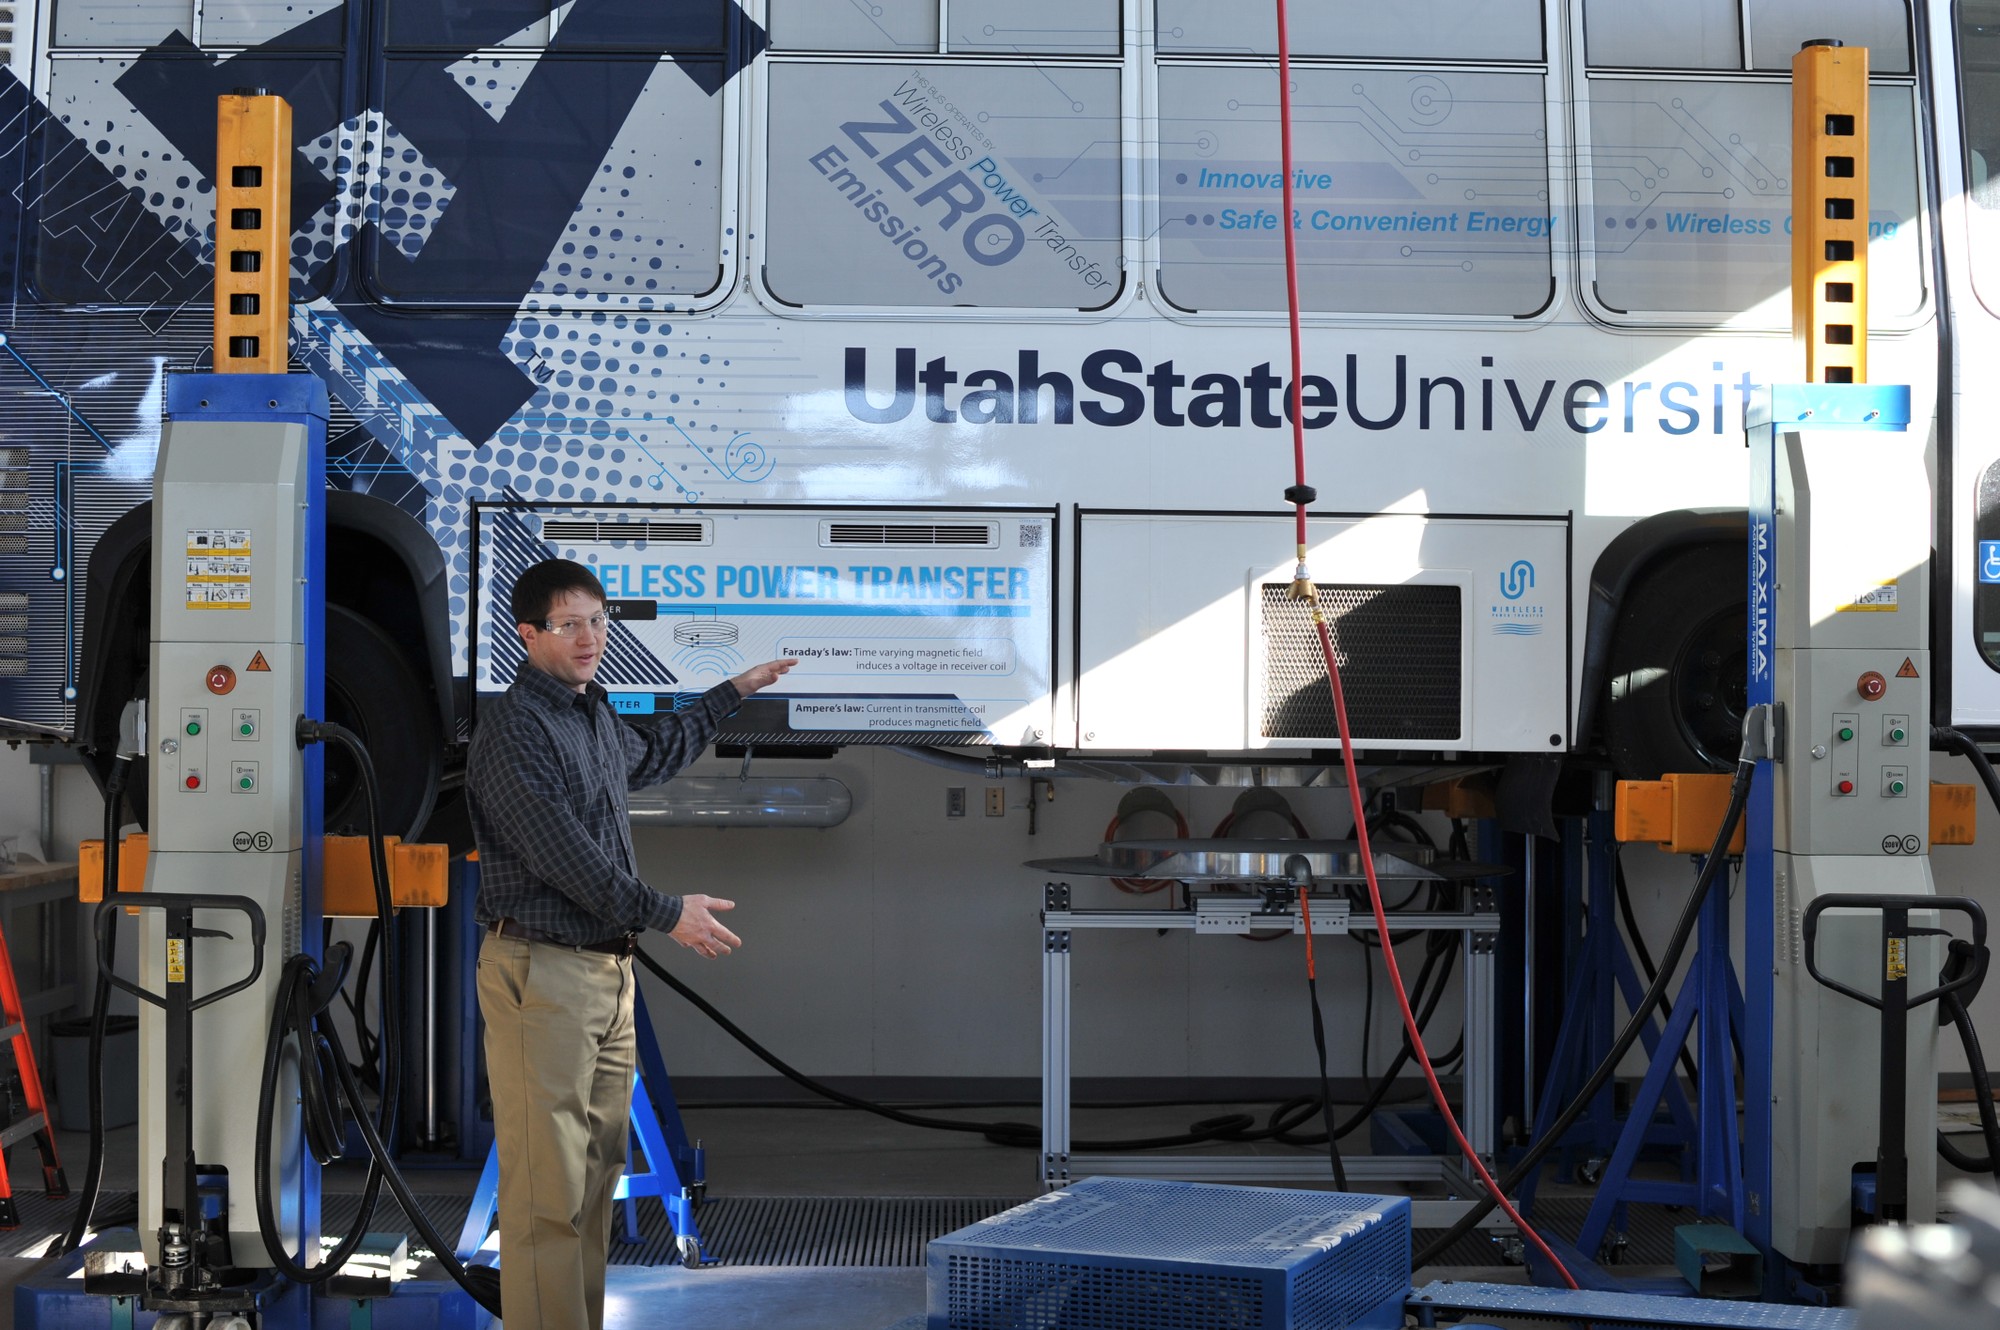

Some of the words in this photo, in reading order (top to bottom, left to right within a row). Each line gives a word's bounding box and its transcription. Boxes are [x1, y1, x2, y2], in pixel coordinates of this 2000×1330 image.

[911, 69, 930, 89] THIS
[927, 86, 947, 105] BUS
[944, 102, 985, 142] OPERATES
[981, 138, 996, 151] BY
[839, 99, 1026, 267] ZERO
[893, 80, 973, 161] Wireless
[968, 157, 1038, 221] Power
[1034, 216, 1113, 291] Transfer
[1198, 167, 1332, 189] Innovaive
[808, 144, 963, 295] Emissions
[1219, 209, 1278, 230] Safe
[1311, 210, 1458, 233] Convenient
[1466, 212, 1557, 238] Energy
[1665, 212, 1772, 235] Wireless
[524, 347, 556, 384] TM
[584, 564, 705, 598] ELESS
[717, 564, 839, 600] POWER
[848, 565, 1031, 601] TRANSFER
[1757, 523, 1767, 675] MAXIMA
[782, 647, 830, 658] Faraday's
[831, 647, 852, 657] law:
[853, 648, 878, 657] Time
[879, 648, 914, 660] varying
[916, 648, 960, 660] magnetic
[962, 648, 983, 658] field
[856, 661, 892, 671] induces
[895, 663, 900, 671] a
[902, 661, 938, 673] voltage
[939, 661, 949, 671] in
[951, 661, 987, 671] receiver
[989, 661, 1006, 671] coil
[795, 704, 842, 715] Ampere's
[843, 704, 865, 714] law:
[866, 704, 901, 714] Current
[904, 704, 913, 713] in
[915, 704, 967, 714] transmitter
[968, 704, 986, 714] coil
[869, 717, 912, 728] produces
[915, 718, 958, 729] magnetic
[960, 718, 982, 728] field
[258, 835, 268, 847] B
[1884, 840, 1899, 849] 208V
[1906, 839, 1916, 850] C
